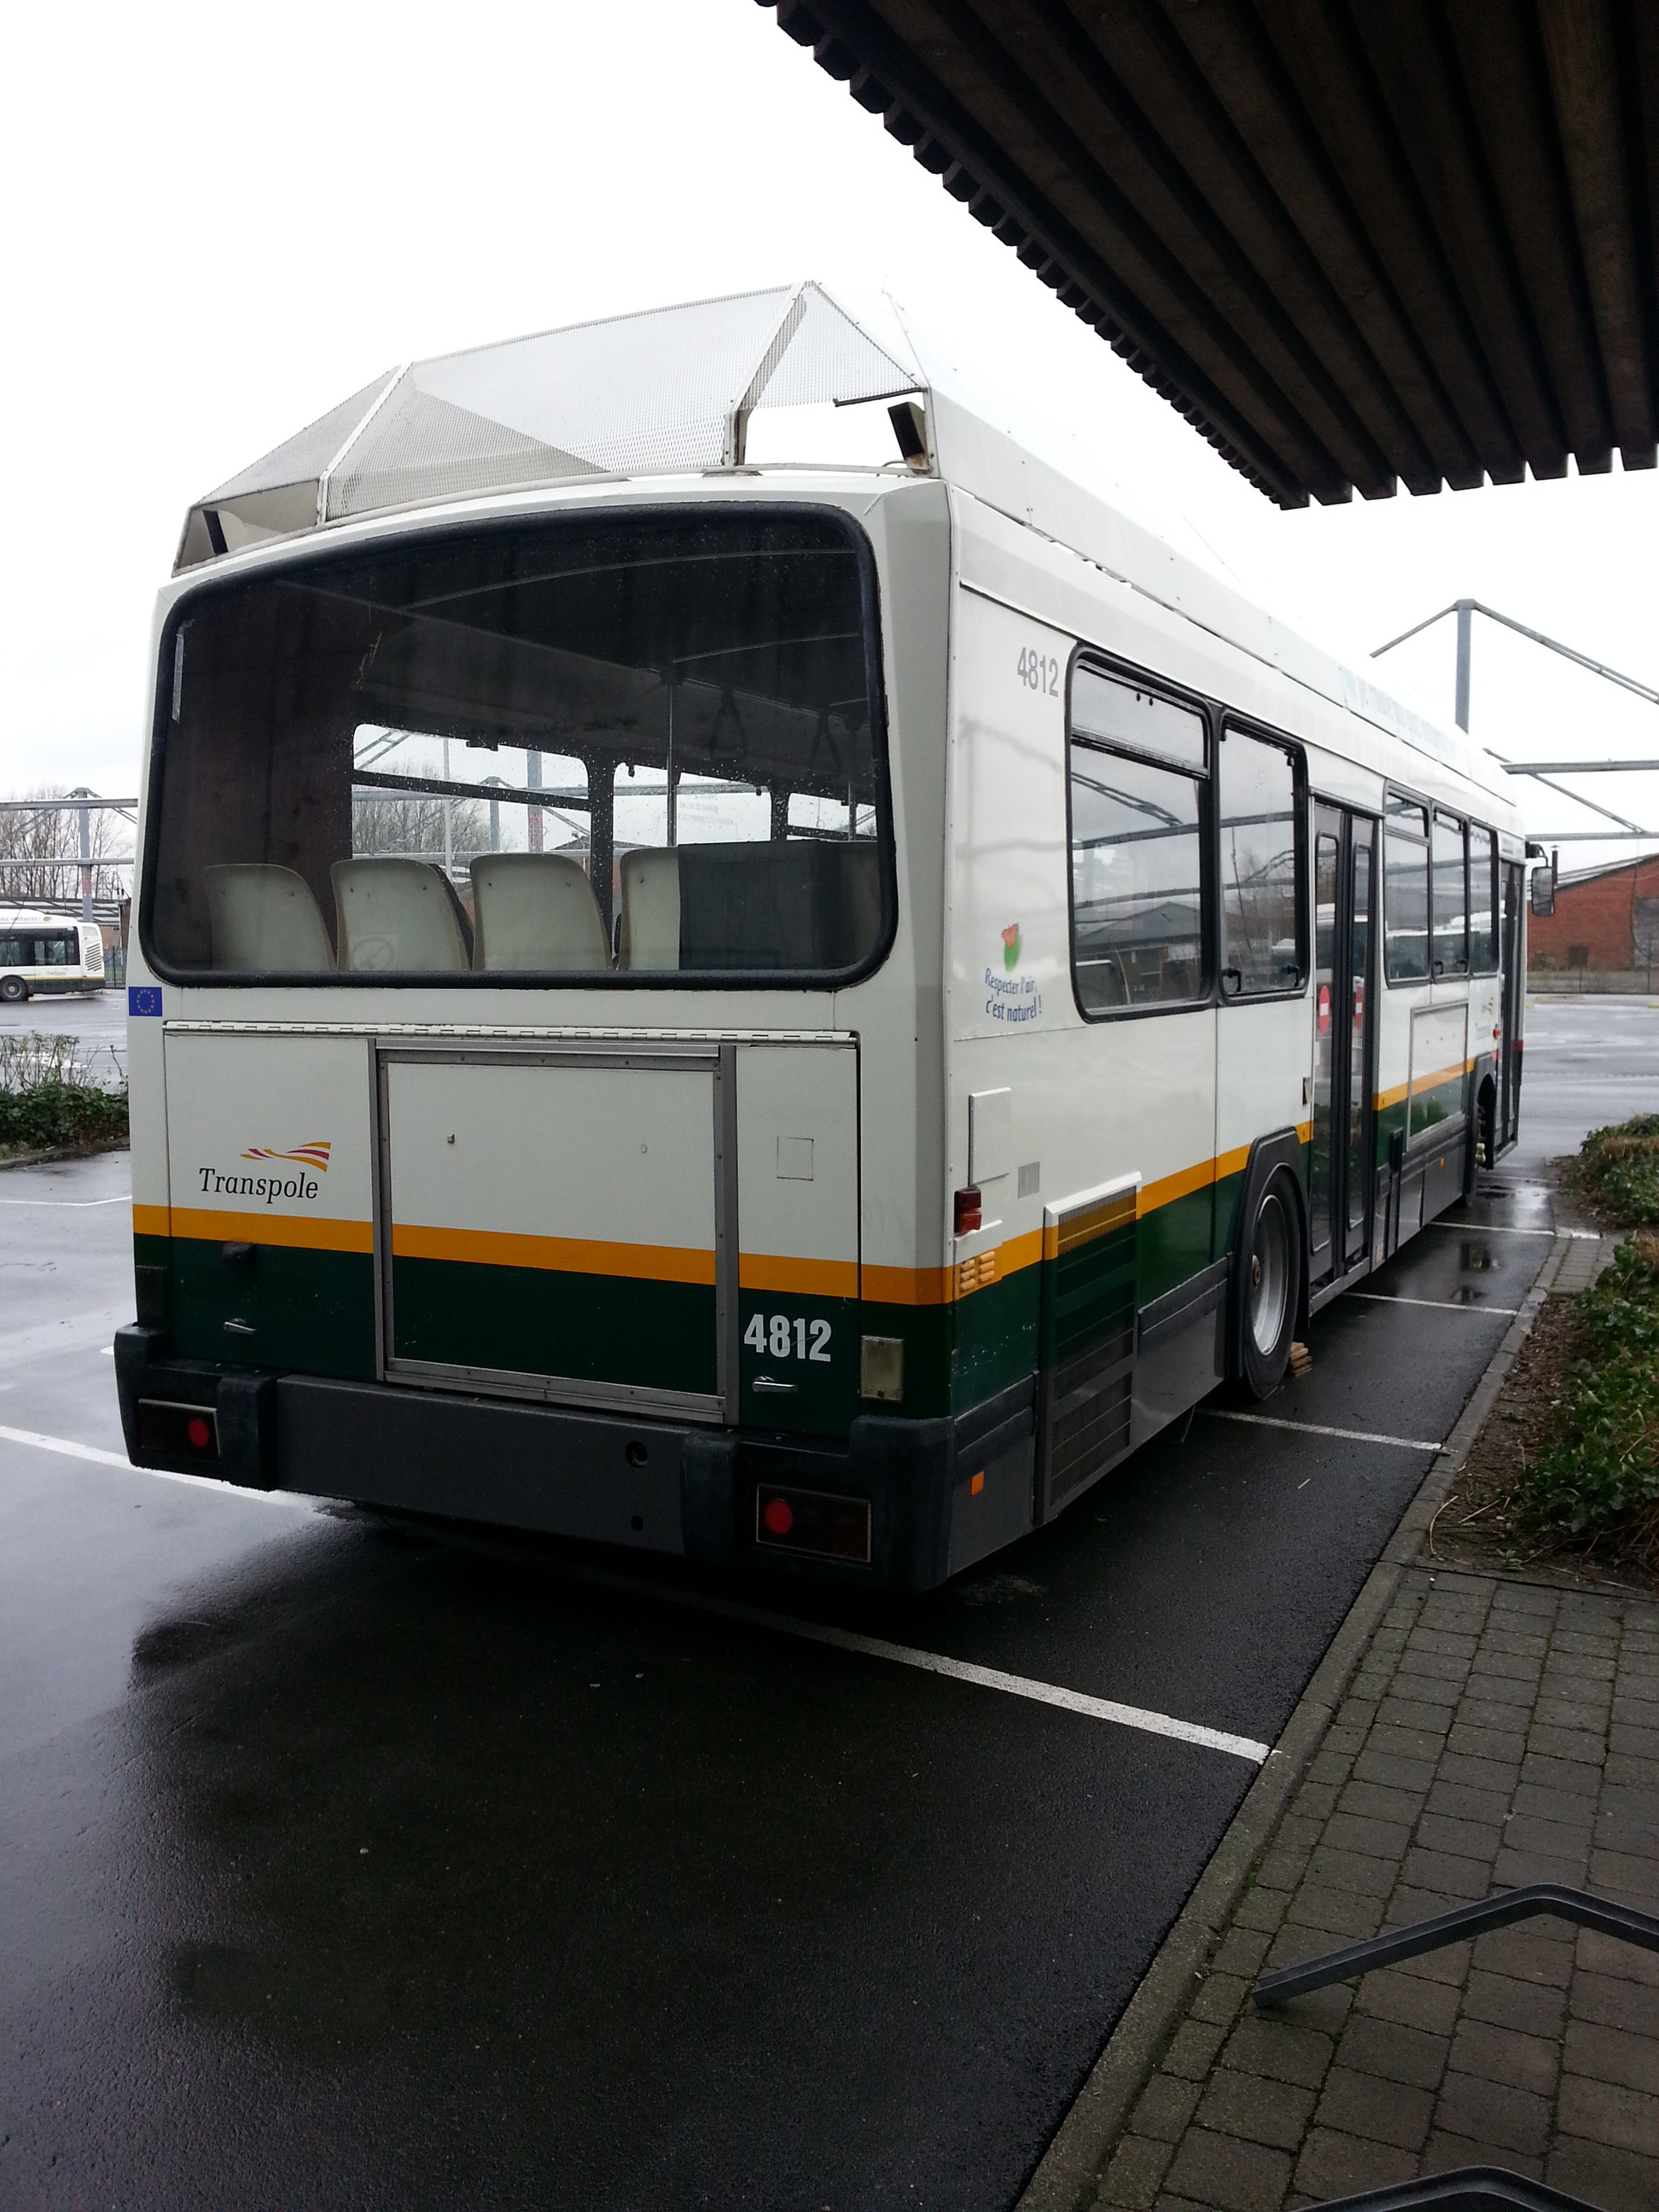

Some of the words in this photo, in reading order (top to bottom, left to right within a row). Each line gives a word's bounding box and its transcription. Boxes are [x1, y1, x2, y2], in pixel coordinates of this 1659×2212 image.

[1016, 646, 1059, 698] 4812
[985, 967, 1020, 997] Respecter
[986, 994, 1005, 1021] c'est
[198, 1167, 319, 1205] Transpole
[743, 1313, 832, 1363] 4812
